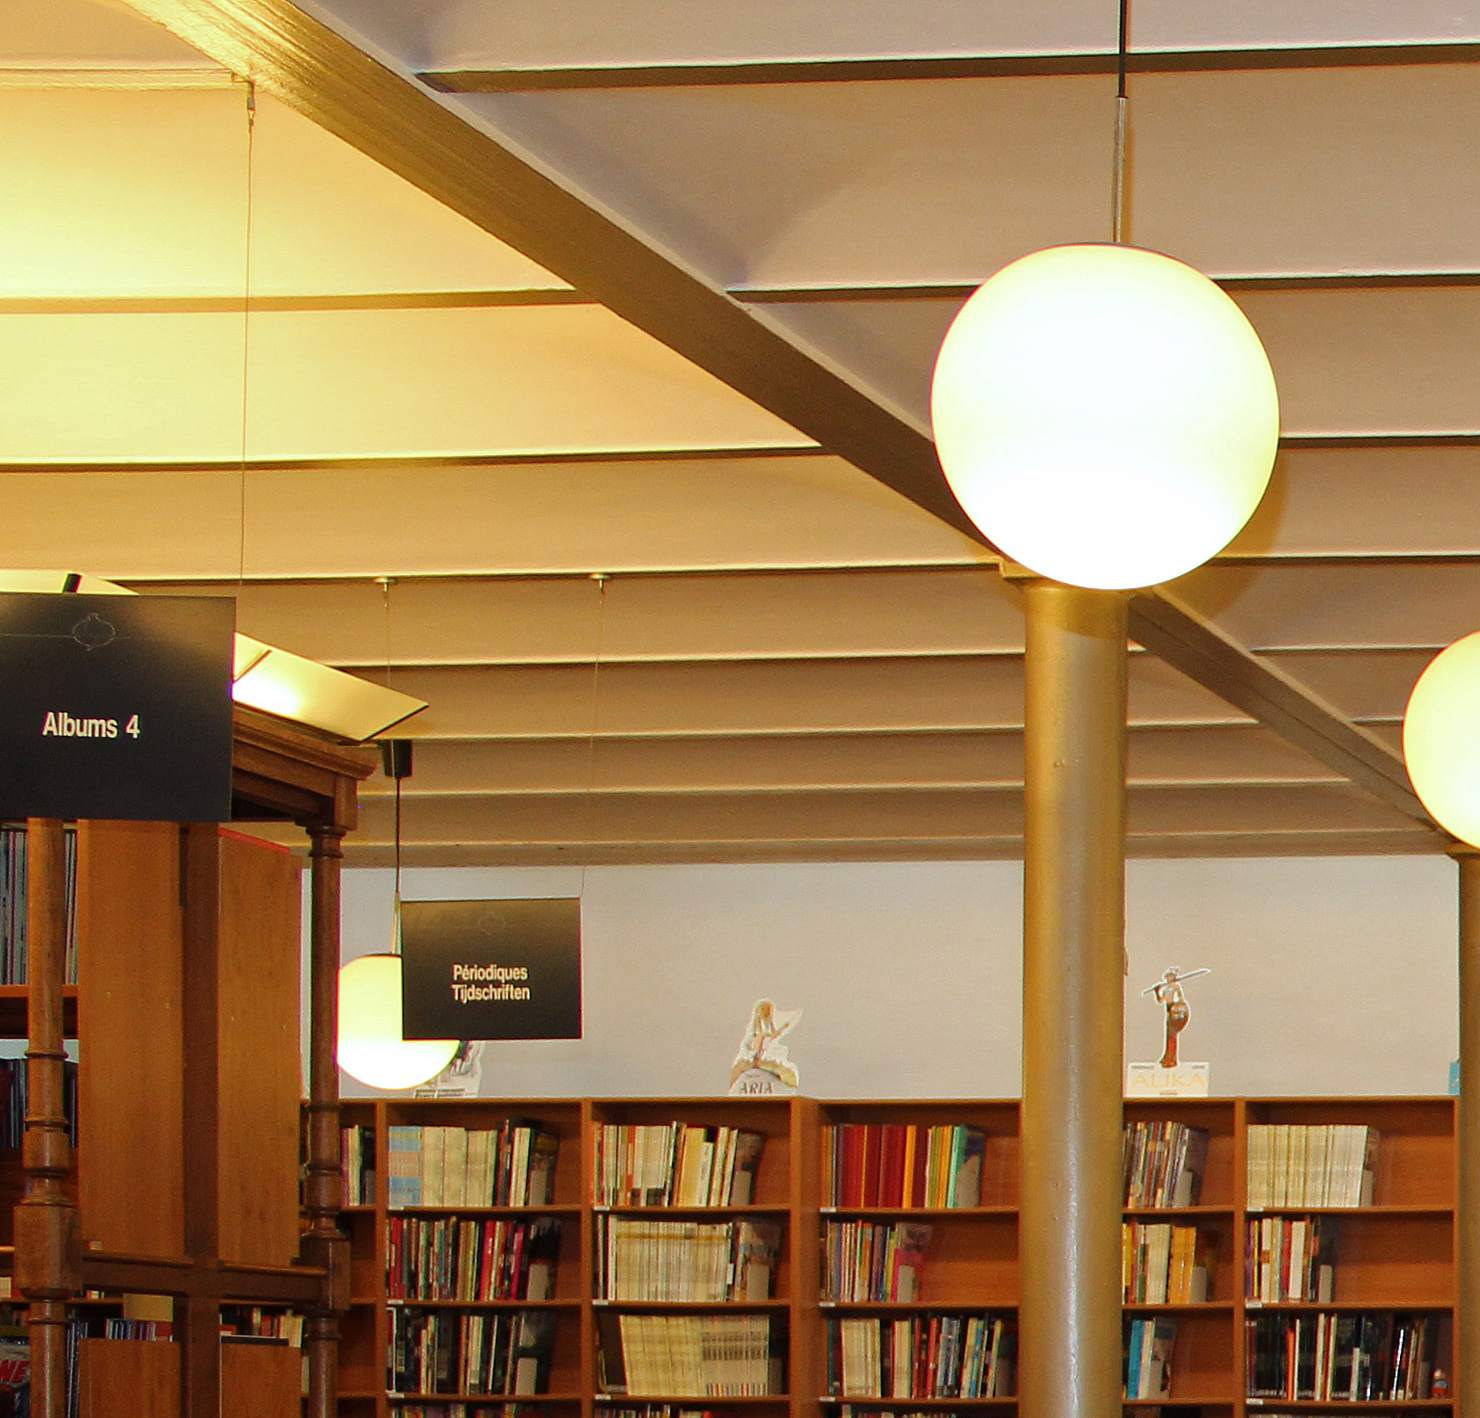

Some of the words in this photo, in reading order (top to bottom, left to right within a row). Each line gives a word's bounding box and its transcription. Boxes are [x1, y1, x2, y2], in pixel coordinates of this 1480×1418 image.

[43, 711, 119, 739] Albums
[126, 714, 141, 739] 4
[453, 964, 529, 983] Périodiques
[452, 984, 532, 1004] Tijdschriften
[739, 1082, 773, 1094] ARIA
[1131, 1072, 1207, 1088] ALIKA
